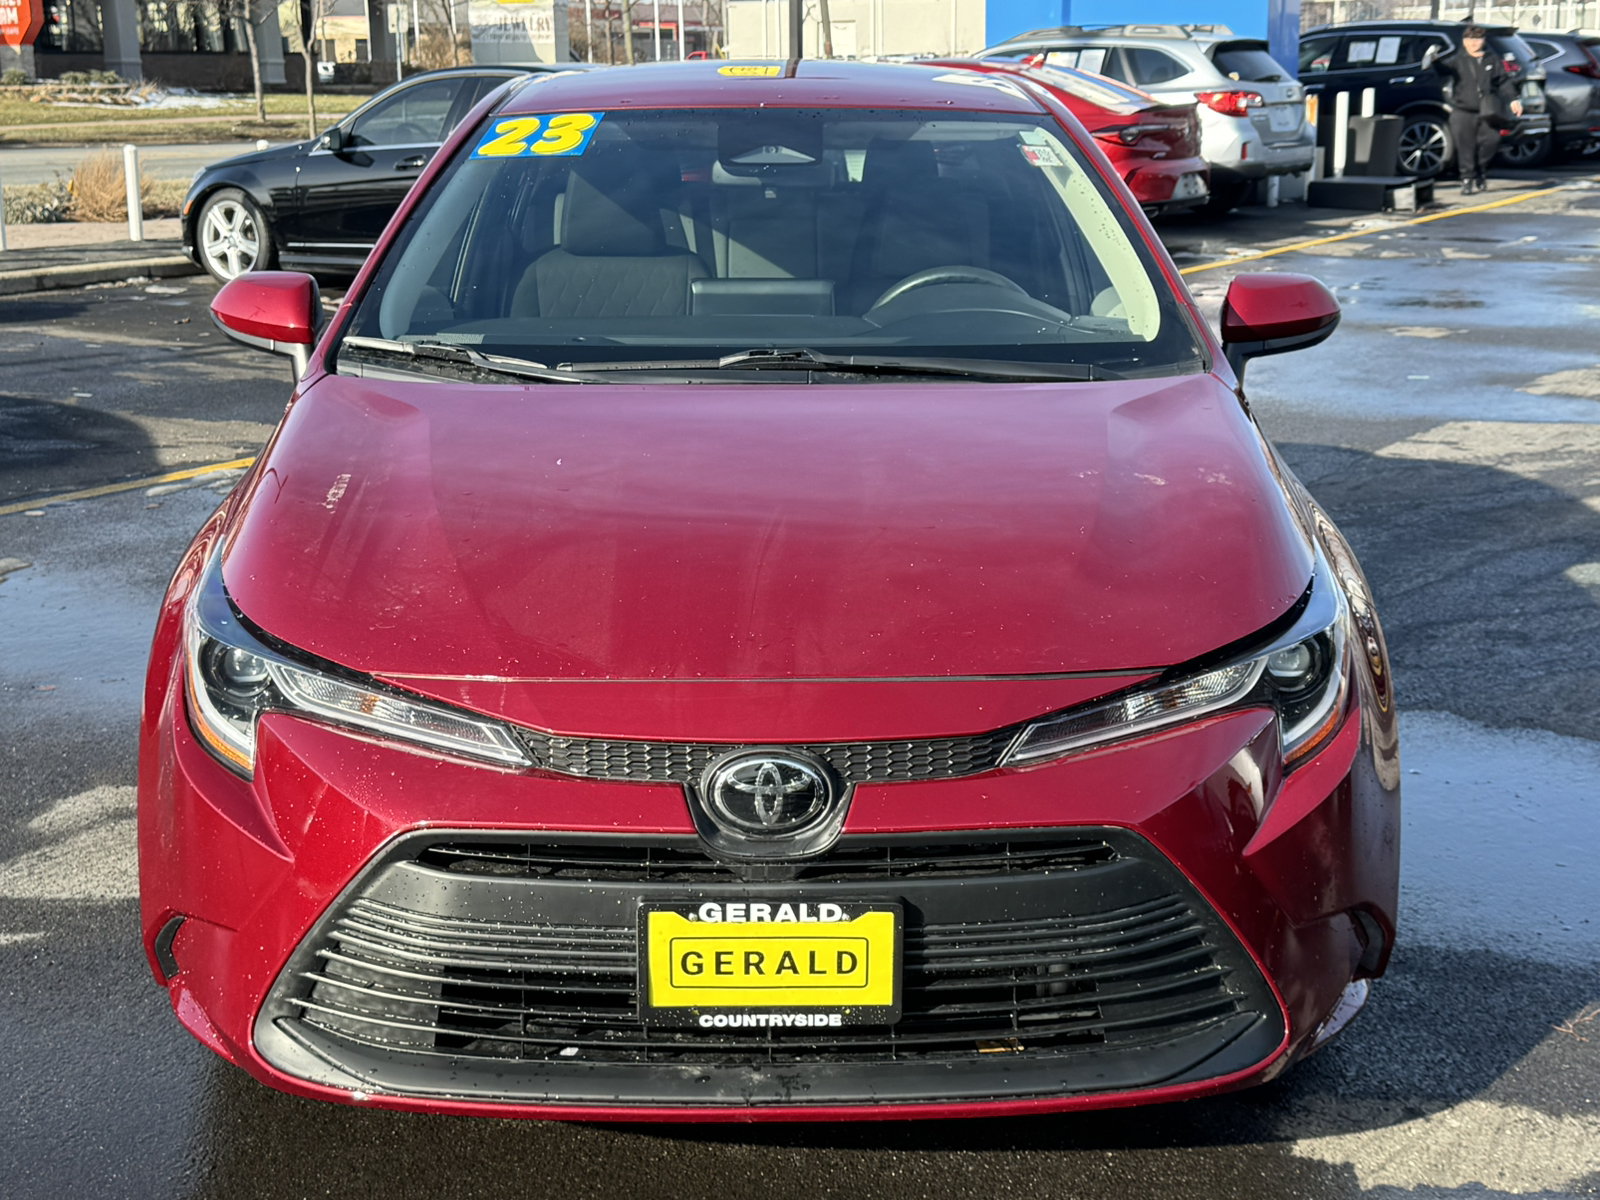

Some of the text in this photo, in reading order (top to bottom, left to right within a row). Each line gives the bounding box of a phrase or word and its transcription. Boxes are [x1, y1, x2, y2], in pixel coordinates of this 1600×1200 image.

[478, 113, 596, 156] 23
[699, 902, 842, 923] GERALD
[680, 950, 858, 976] GERALD
[699, 1013, 842, 1028] COUNTRYSIDE
